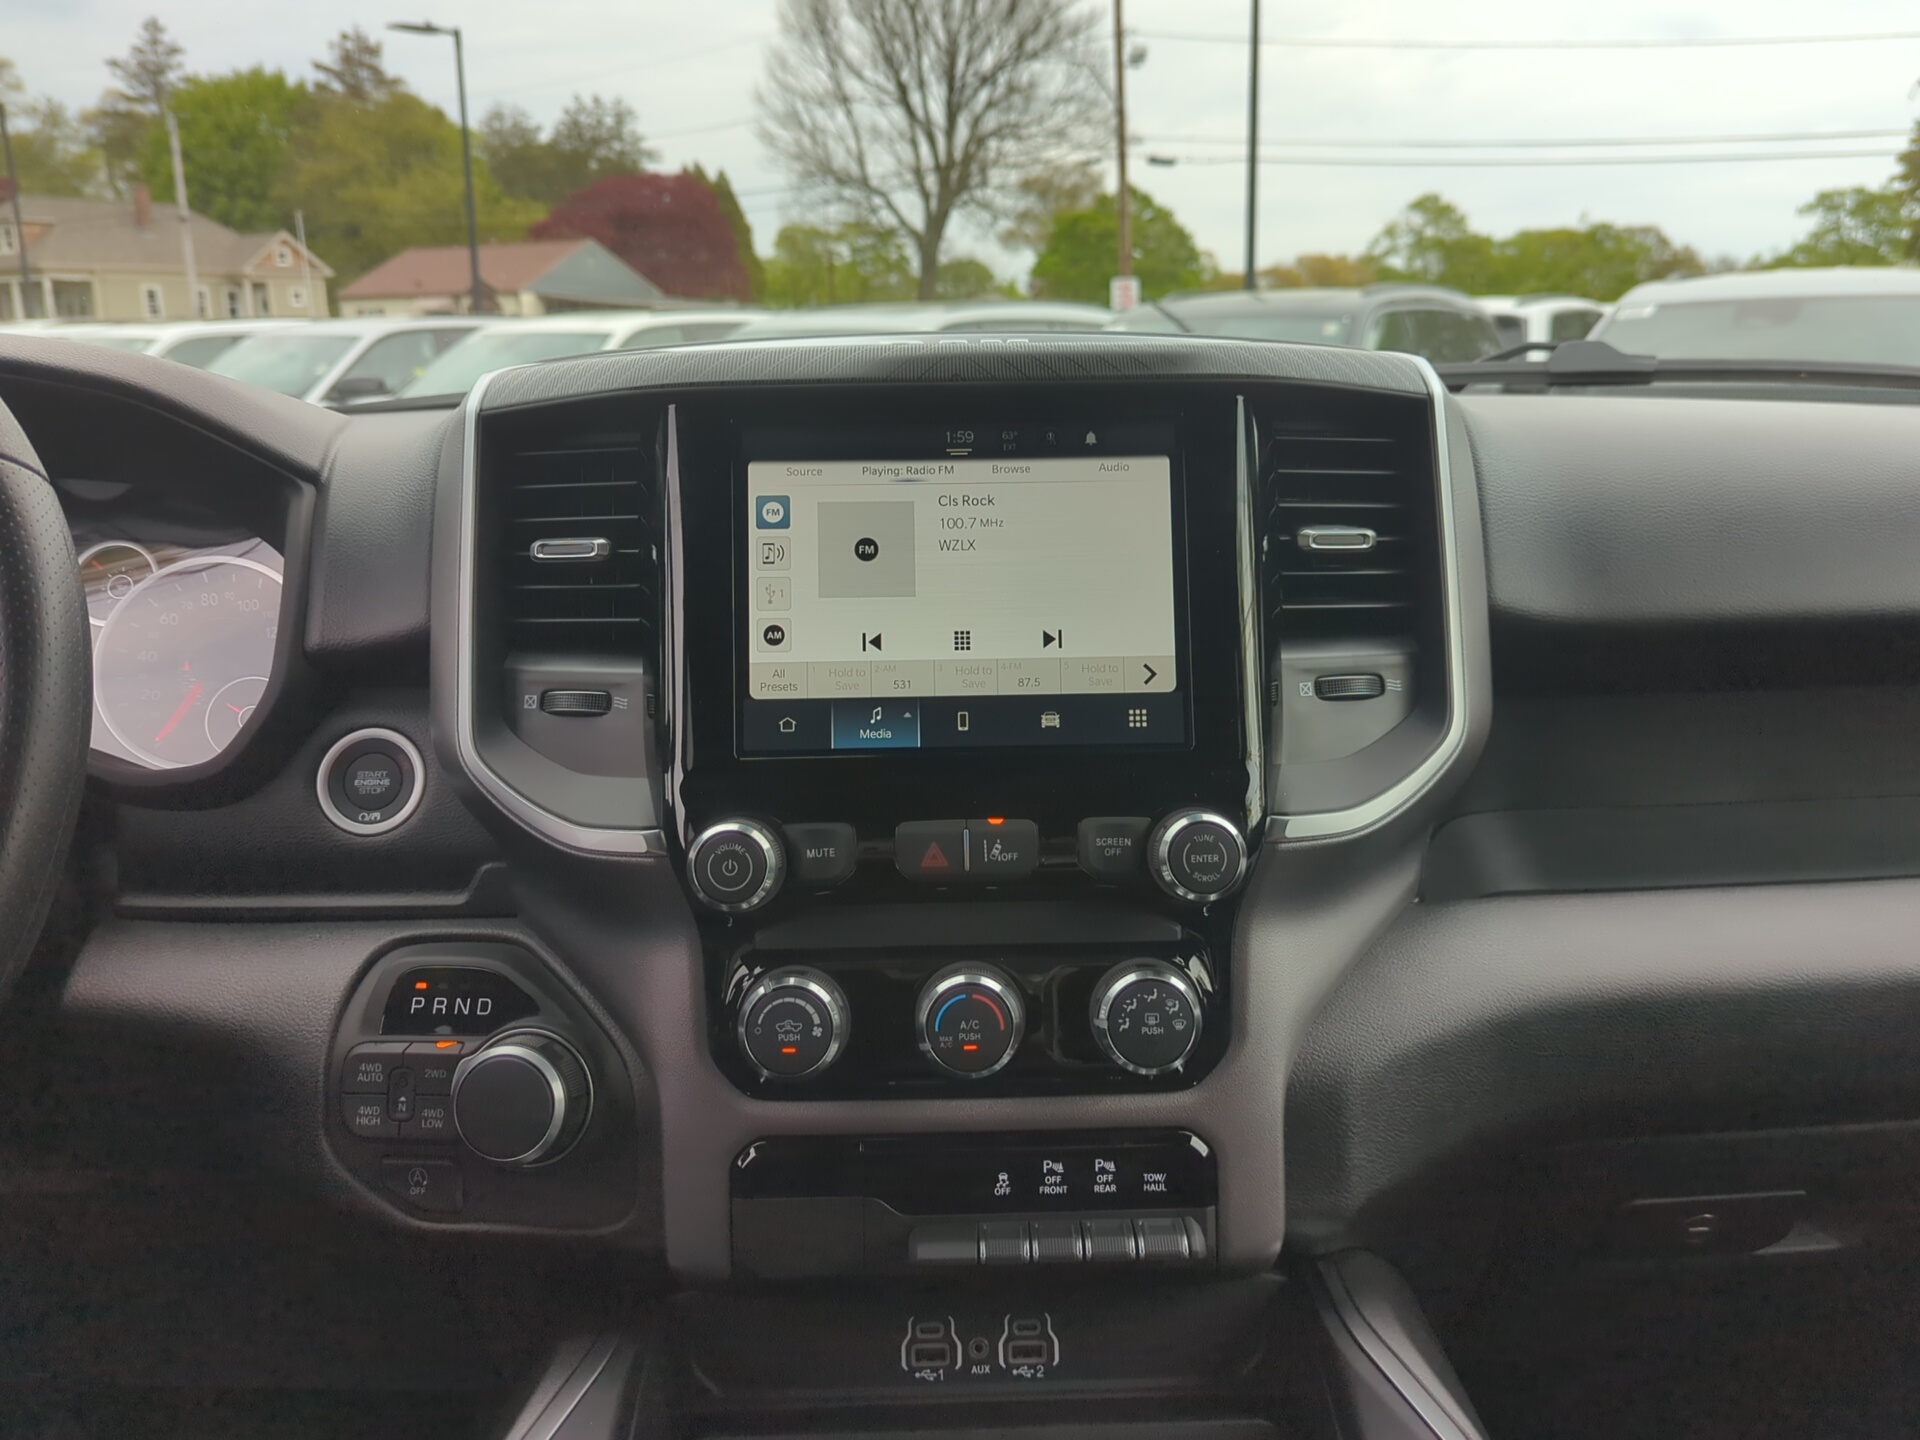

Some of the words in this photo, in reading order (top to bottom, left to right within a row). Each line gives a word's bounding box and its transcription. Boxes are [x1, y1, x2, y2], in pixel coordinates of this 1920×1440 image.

[946, 430, 974, 444] 1:59
[1003, 443, 1016, 452] EXT
[786, 466, 823, 477] Source
[862, 466, 904, 478] Playing:
[906, 465, 936, 476] Radio
[938, 465, 954, 475] FM
[991, 464, 1031, 474] Browse
[1098, 462, 1130, 472] Audio
[938, 494, 959, 507] Cls
[962, 494, 996, 506] Rock
[765, 508, 780, 517] FM
[940, 517, 977, 530] 100.7
[980, 519, 1004, 528] MHz
[858, 546, 874, 554] FM
[938, 538, 977, 552] WZLX
[200, 592, 218, 606] 80
[236, 598, 260, 612] 100
[160, 612, 179, 626] 60
[264, 626, 277, 639] 12
[767, 630, 782, 640] AM
[136, 650, 158, 662] 40
[772, 668, 786, 678] All
[828, 668, 853, 678] Hold
[855, 668, 866, 677] to
[955, 666, 980, 676] Hold
[982, 666, 992, 676] to
[1081, 664, 1106, 674] Hold
[1108, 664, 1119, 673] to
[760, 682, 798, 692] Presets
[834, 682, 860, 690] Save
[892, 680, 912, 690] 531
[962, 679, 986, 688] Save
[1017, 678, 1041, 688] 87.5
[1088, 678, 1113, 687] Save
[140, 689, 160, 700] 20
[860, 728, 892, 739] Media
[356, 770, 388, 778] START
[354, 778, 391, 786] ENGINE
[358, 787, 386, 795] STOP
[1095, 837, 1132, 847] SCREEN
[1193, 834, 1216, 844] TUNE
[714, 842, 747, 856] VOLUME
[806, 847, 836, 860] MUTE
[1104, 848, 1122, 856] OFF
[1001, 852, 1020, 861] OFF
[1190, 854, 1220, 864] ENTER
[1192, 870, 1220, 882] SCROLL
[960, 1020, 980, 1030] A/C
[1141, 1026, 1164, 1036] PUSH
[778, 1033, 800, 1042] PUSH
[958, 1032, 981, 1041] PUSH
[358, 1062, 382, 1072] 4WD
[356, 1072, 384, 1082] AUTO
[424, 1068, 447, 1079] 2WD
[357, 1106, 380, 1116] 4WD
[398, 1102, 406, 1112] N
[421, 1108, 445, 1118] 4WD
[356, 1116, 380, 1126] HIGH
[421, 1119, 444, 1129] LOW
[1044, 1176, 1062, 1186] OFF
[1096, 1174, 1114, 1184] OFF
[409, 1186, 426, 1196] OFF
[994, 1186, 1012, 1196] OFF
[1039, 1186, 1068, 1195] FRONT
[1094, 1184, 1117, 1194] REAR
[1143, 1182, 1168, 1192] HAUL
[970, 1364, 991, 1376] AUX
[1036, 1364, 1044, 1378] 2
